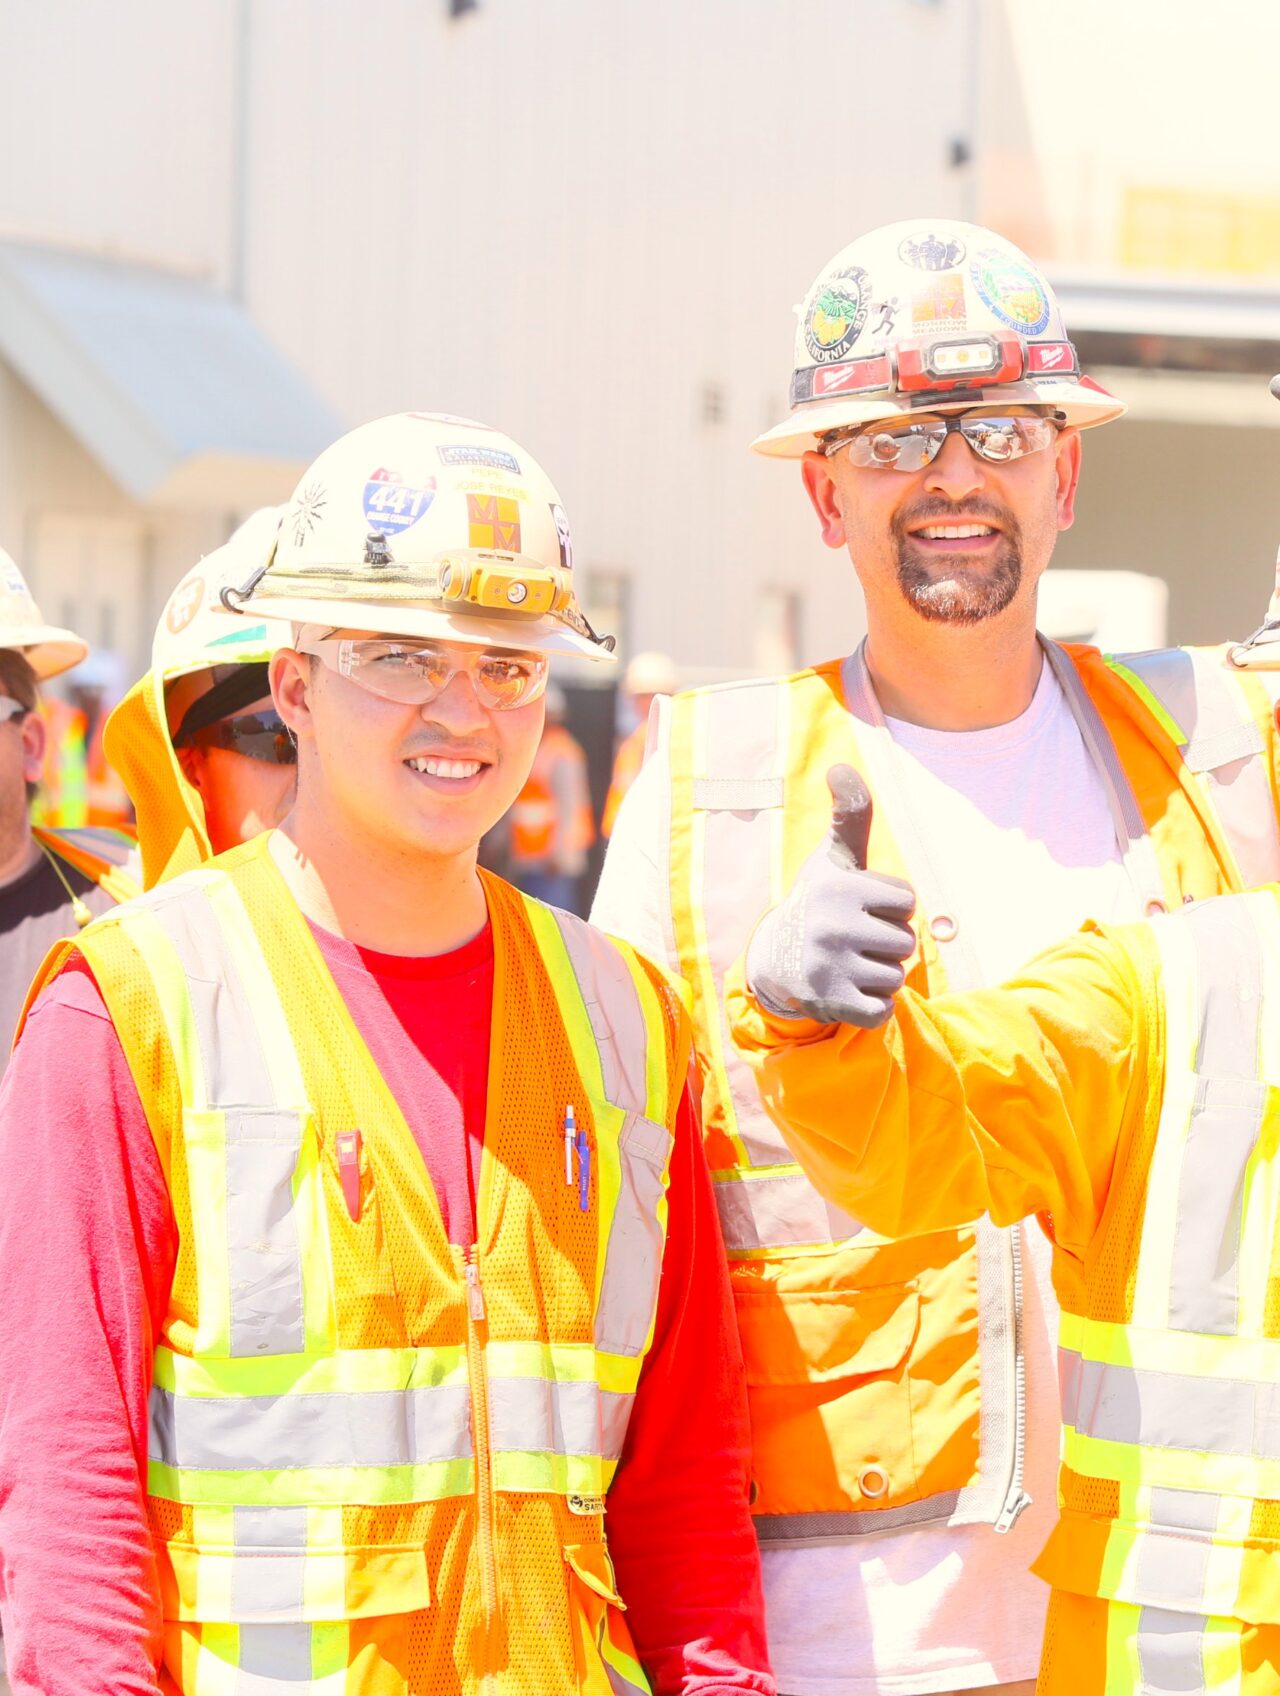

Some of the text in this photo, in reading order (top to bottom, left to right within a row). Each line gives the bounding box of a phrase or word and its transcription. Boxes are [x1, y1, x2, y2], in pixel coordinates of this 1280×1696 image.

[911, 319, 968, 328] MORROW
[911, 325, 968, 335] MEADOWS
[472, 468, 503, 480] PEPE
[369, 485, 423, 516] 441
